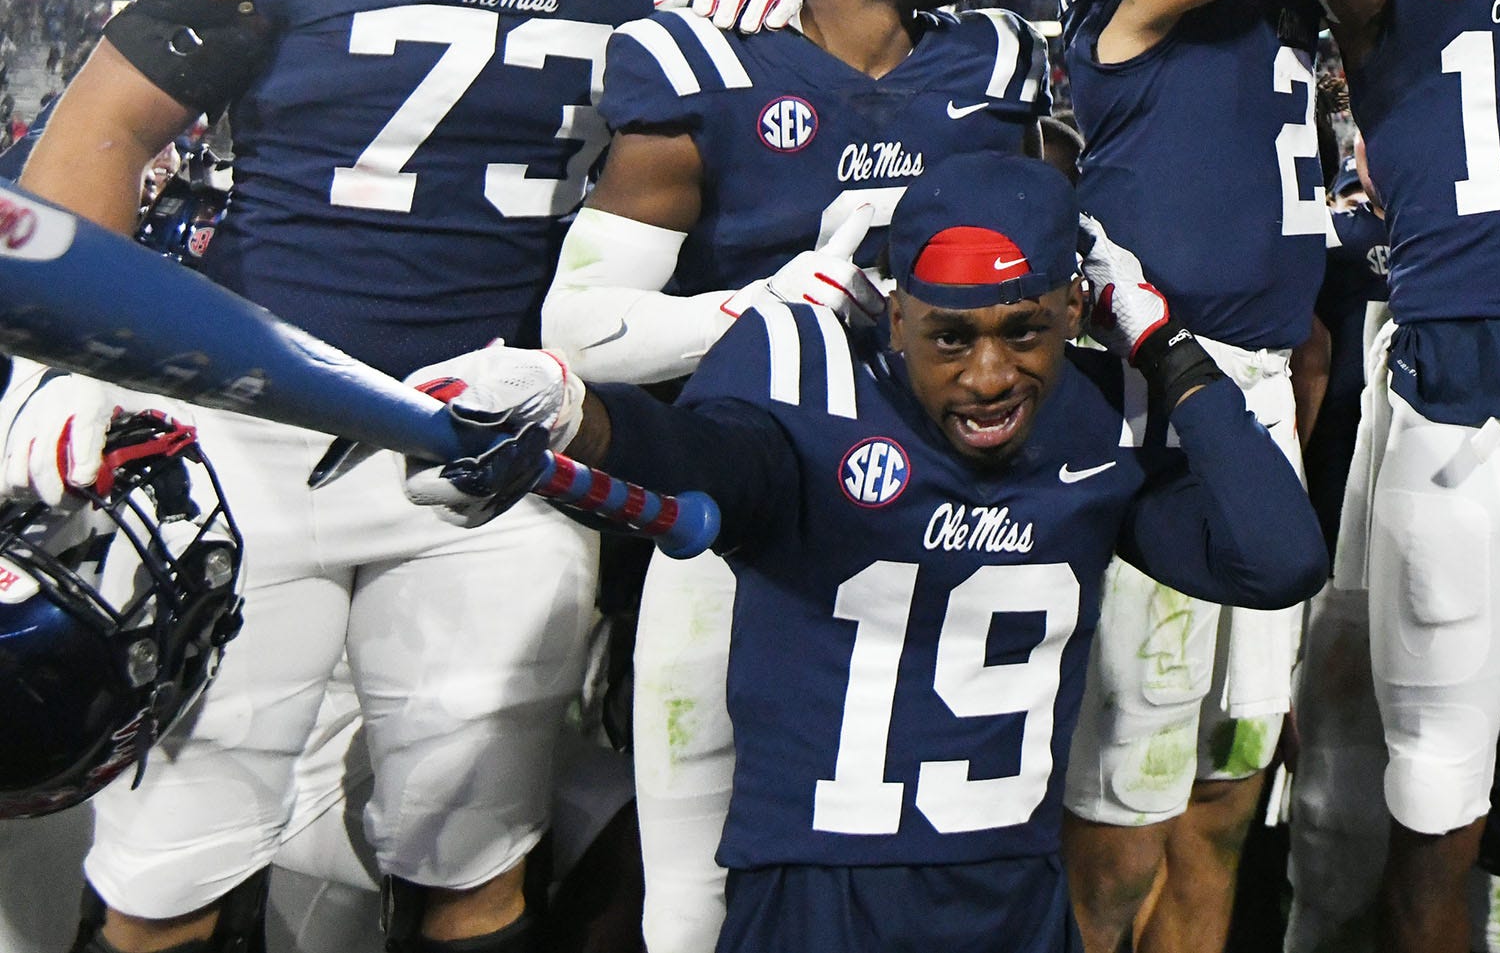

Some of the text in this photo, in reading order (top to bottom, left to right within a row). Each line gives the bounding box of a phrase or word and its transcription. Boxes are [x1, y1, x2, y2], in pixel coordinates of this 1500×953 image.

[330, 4, 613, 218] 73
[762, 99, 814, 149] SEC
[837, 142, 924, 182] Ole Miss
[1273, 46, 1327, 237] 2
[1366, 246, 1390, 276] SE
[844, 442, 905, 503] SEC
[922, 502, 1034, 554] Ole Miss
[812, 560, 1081, 835] 19
